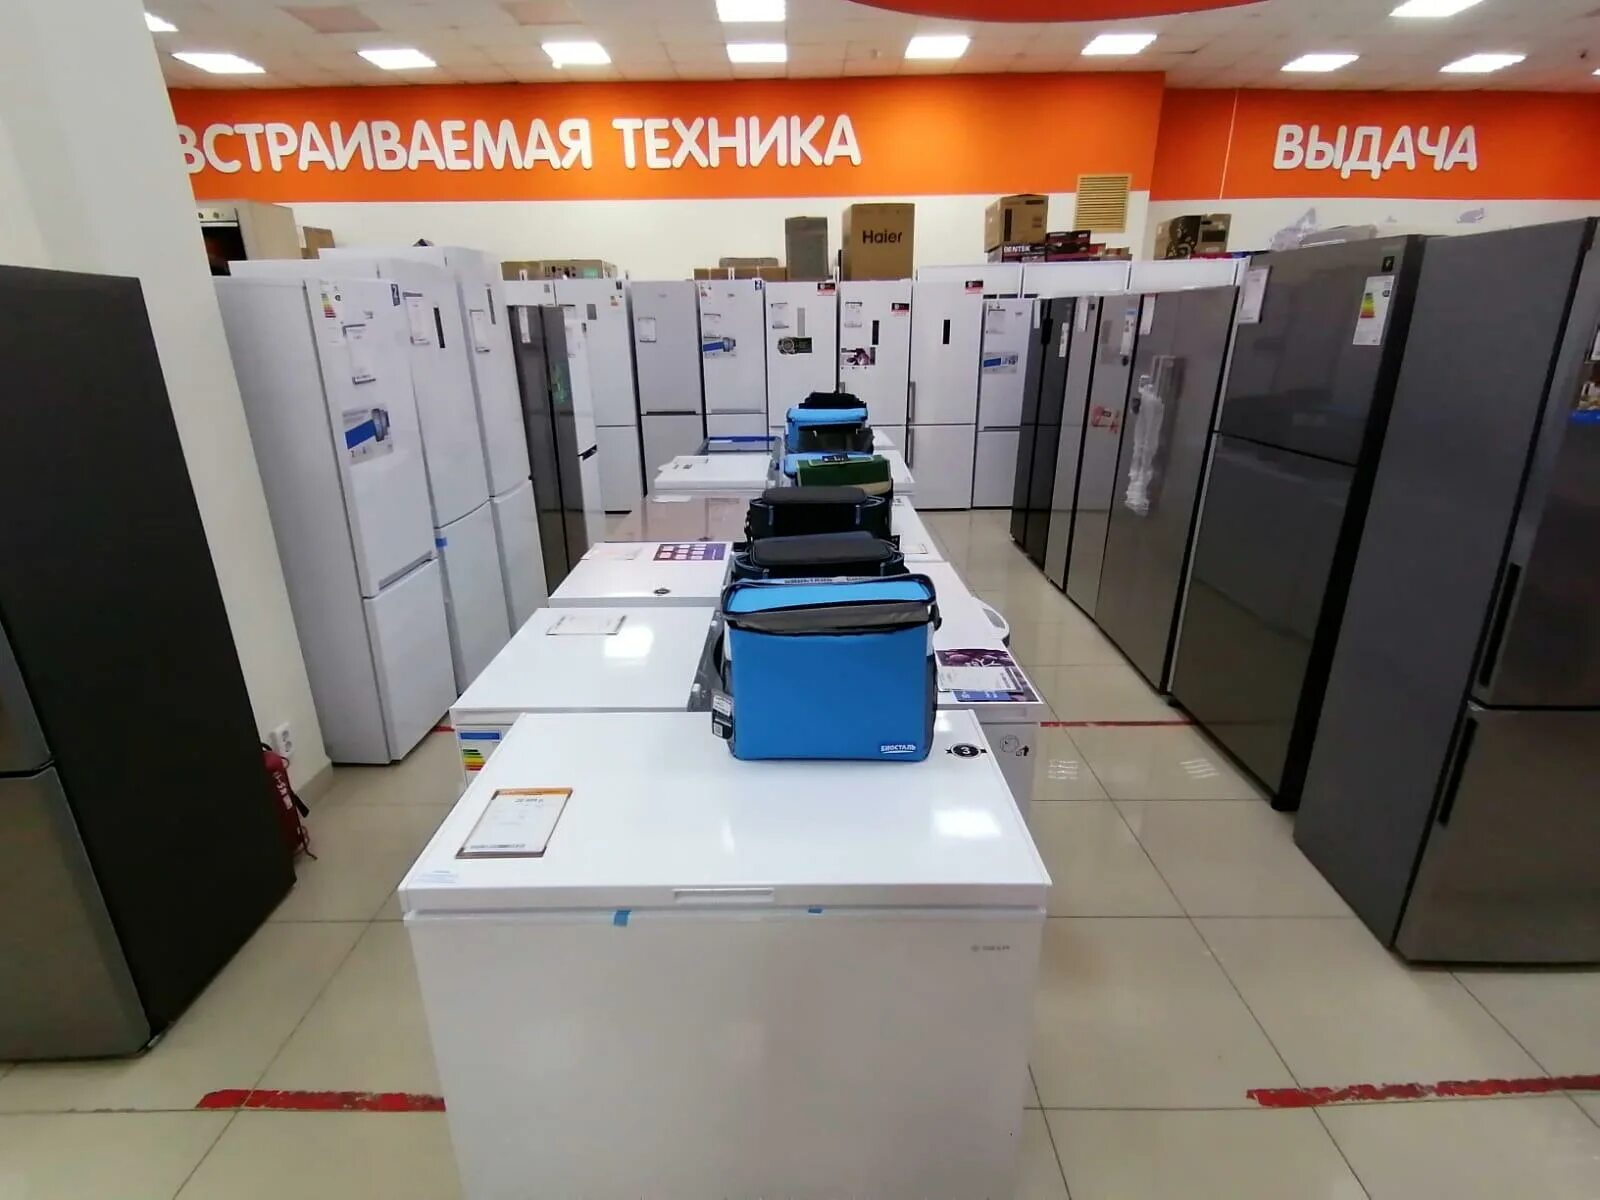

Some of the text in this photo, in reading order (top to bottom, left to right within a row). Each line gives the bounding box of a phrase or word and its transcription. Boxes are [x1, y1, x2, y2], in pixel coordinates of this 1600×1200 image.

[177, 114, 862, 174] ВСТРАИВАЕМАЯ ТЕХНИКА
[1273, 124, 1478, 180] ВЫДАЧА
[862, 228, 903, 244] Haier
[960, 746, 971, 755] 3
